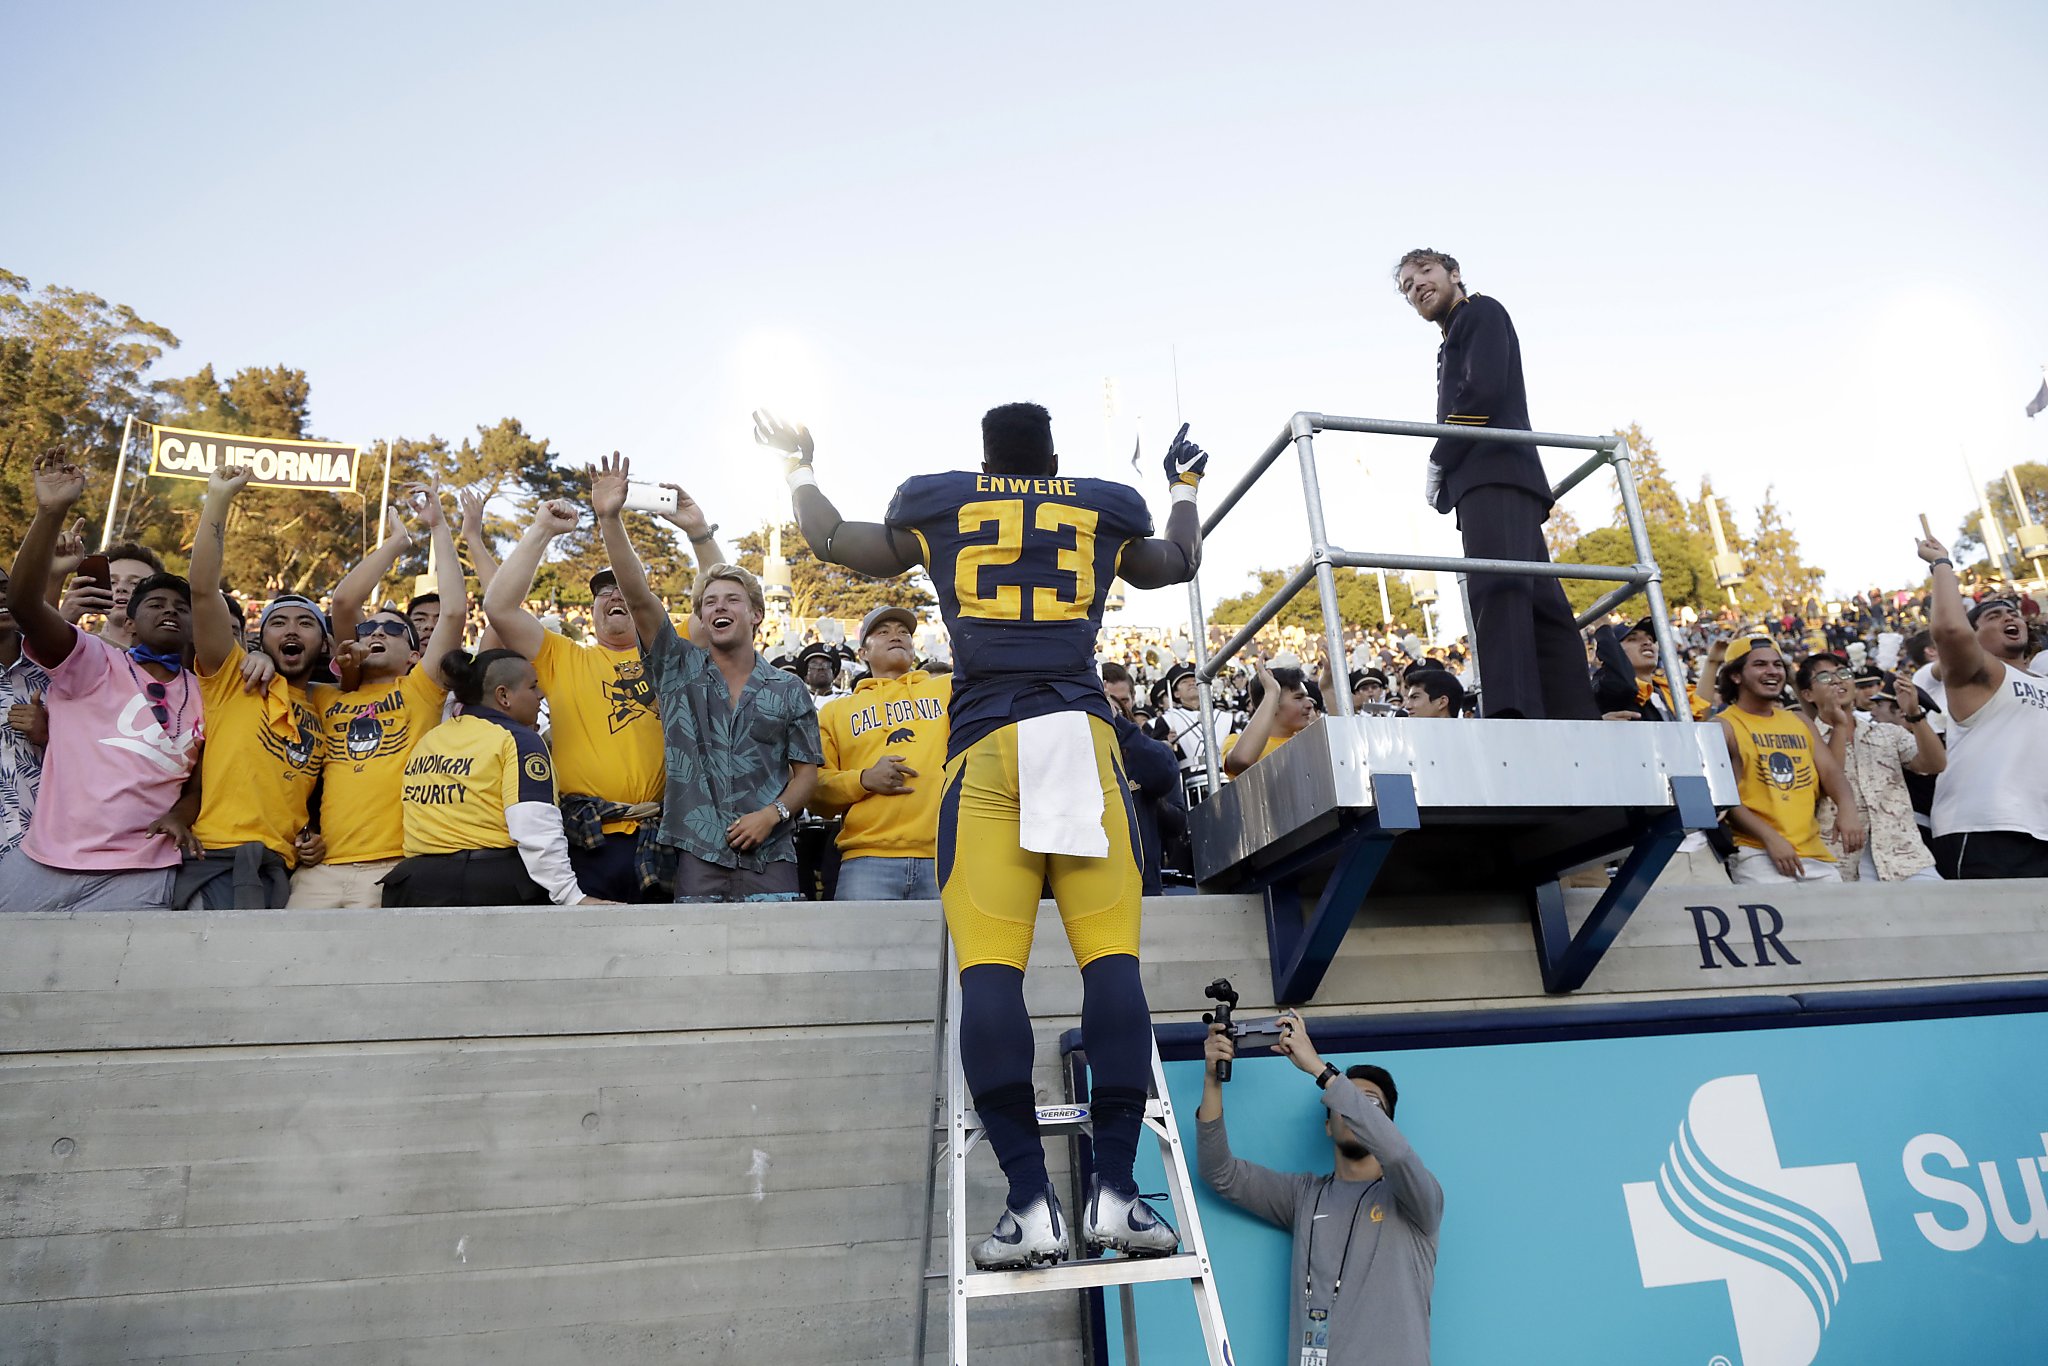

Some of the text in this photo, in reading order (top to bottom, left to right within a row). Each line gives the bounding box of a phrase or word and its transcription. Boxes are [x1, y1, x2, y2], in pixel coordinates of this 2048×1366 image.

[159, 437, 351, 483] CALIFORNIA
[976, 474, 1077, 496] ENWERE
[954, 499, 1099, 621] 23
[634, 681, 649, 696] 10
[851, 698, 943, 737] CALFORNIA
[404, 755, 470, 776] LANDMARK
[402, 783, 467, 805] ECURITY
[1684, 904, 1802, 969] RR
